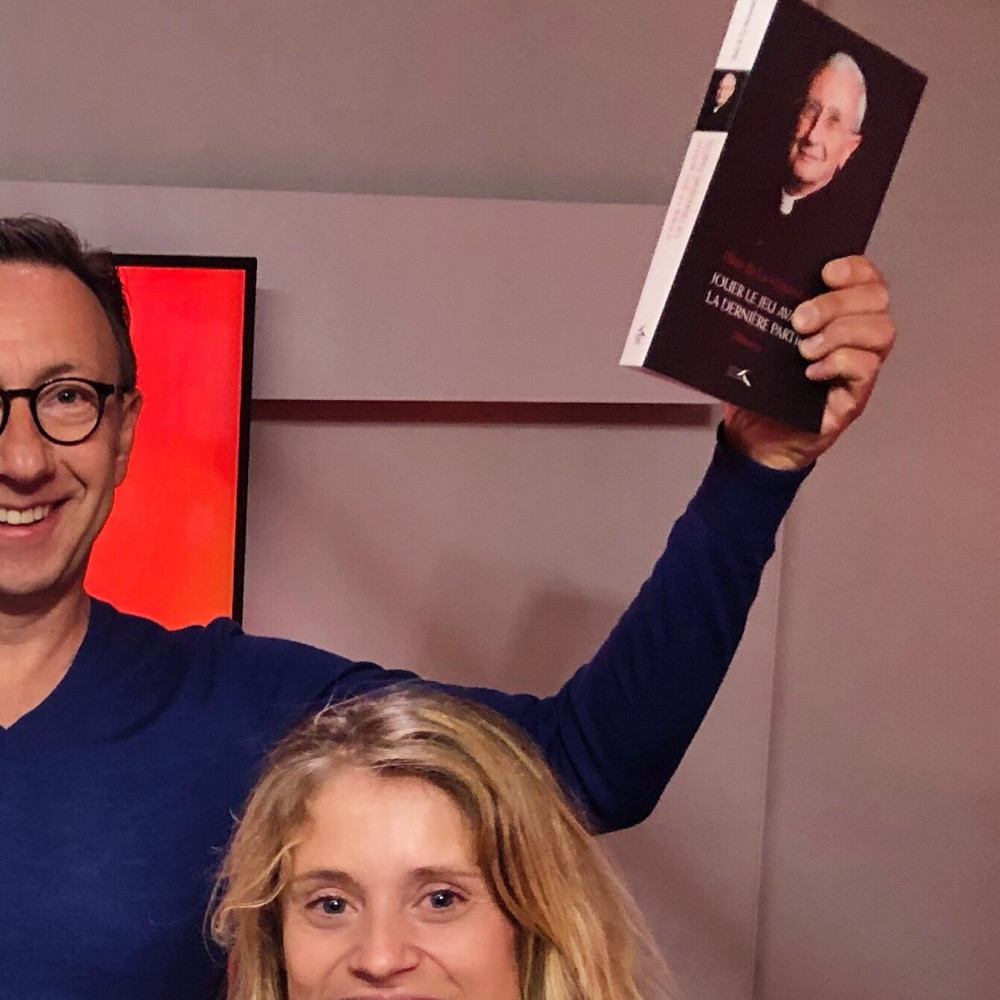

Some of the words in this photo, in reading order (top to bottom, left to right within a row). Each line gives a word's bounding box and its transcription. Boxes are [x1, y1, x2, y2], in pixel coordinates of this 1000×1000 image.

[704, 290, 720, 308] LA
[720, 297, 770, 332] DERNIÈRE
[710, 271, 746, 299] JOUER
[744, 288, 759, 305] LE
[757, 295, 778, 314] JEU
[776, 305, 795, 321] AV
